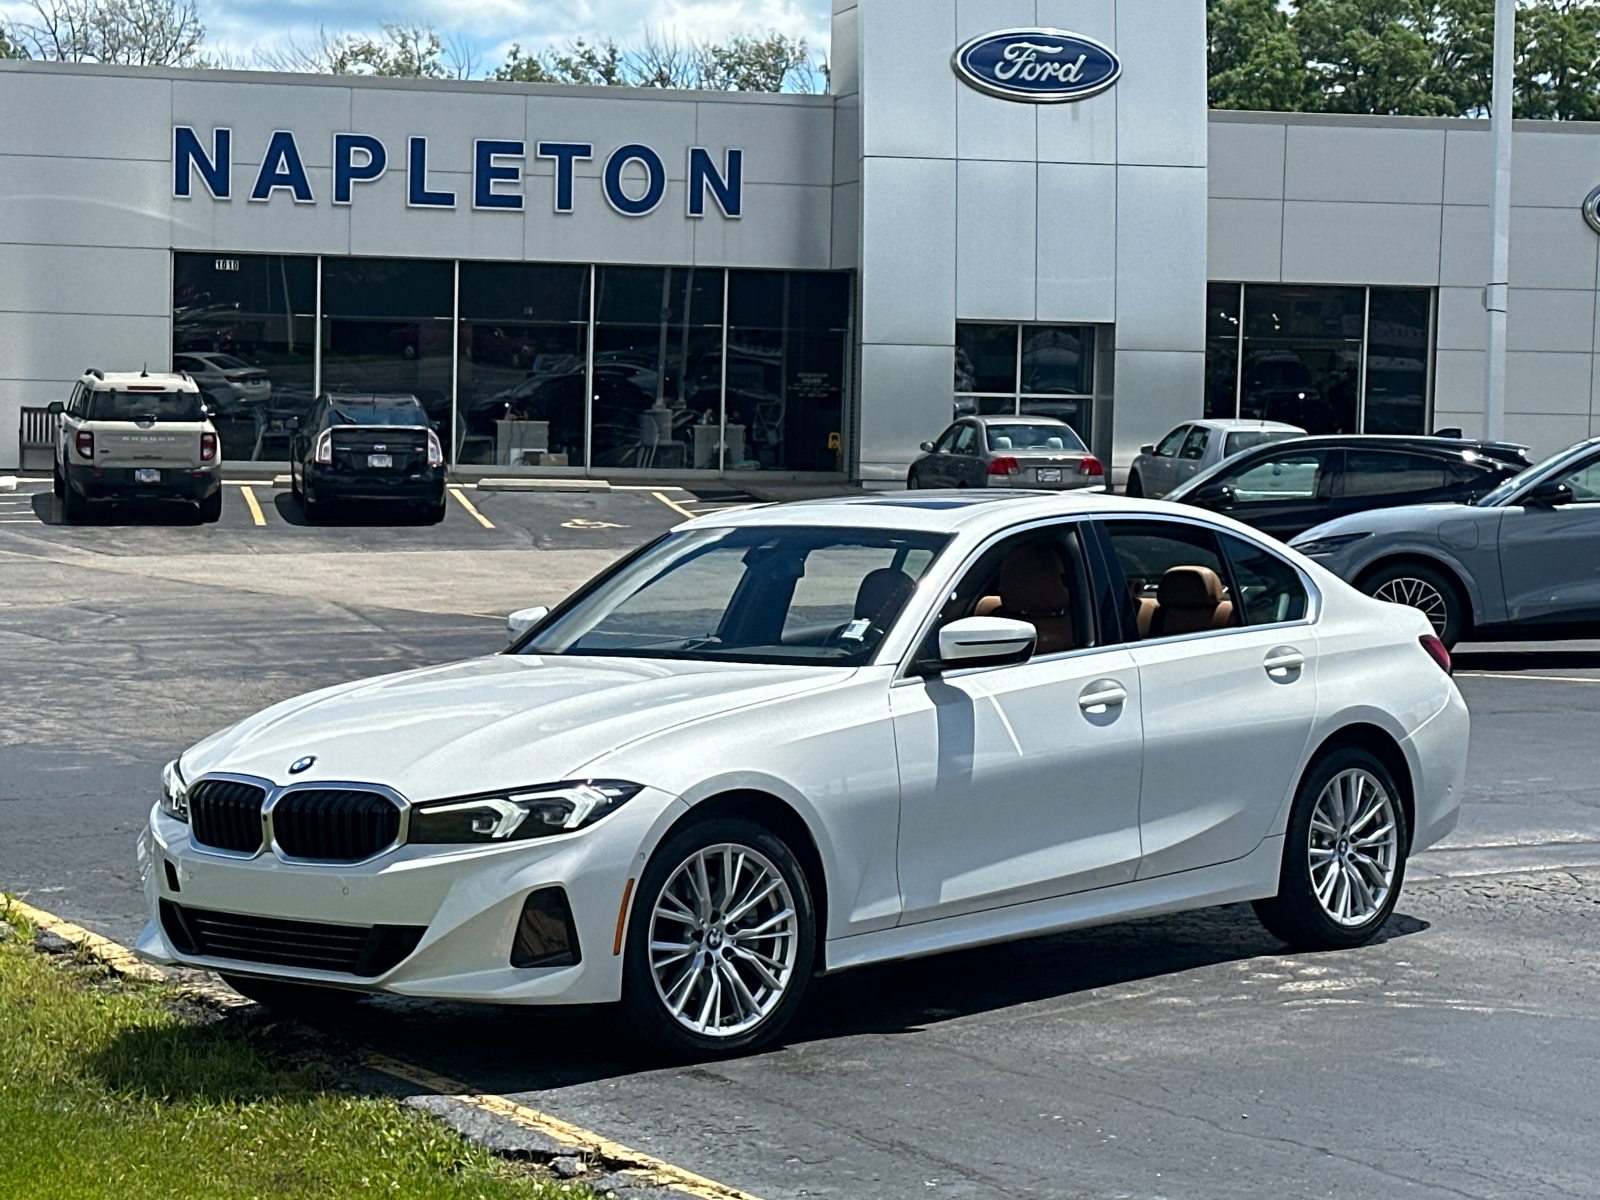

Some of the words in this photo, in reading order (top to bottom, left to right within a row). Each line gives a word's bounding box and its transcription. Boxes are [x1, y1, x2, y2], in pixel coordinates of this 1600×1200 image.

[995, 42, 1087, 83] Ford
[172, 125, 743, 219] NAPLETON
[215, 260, 238, 270] 1010
